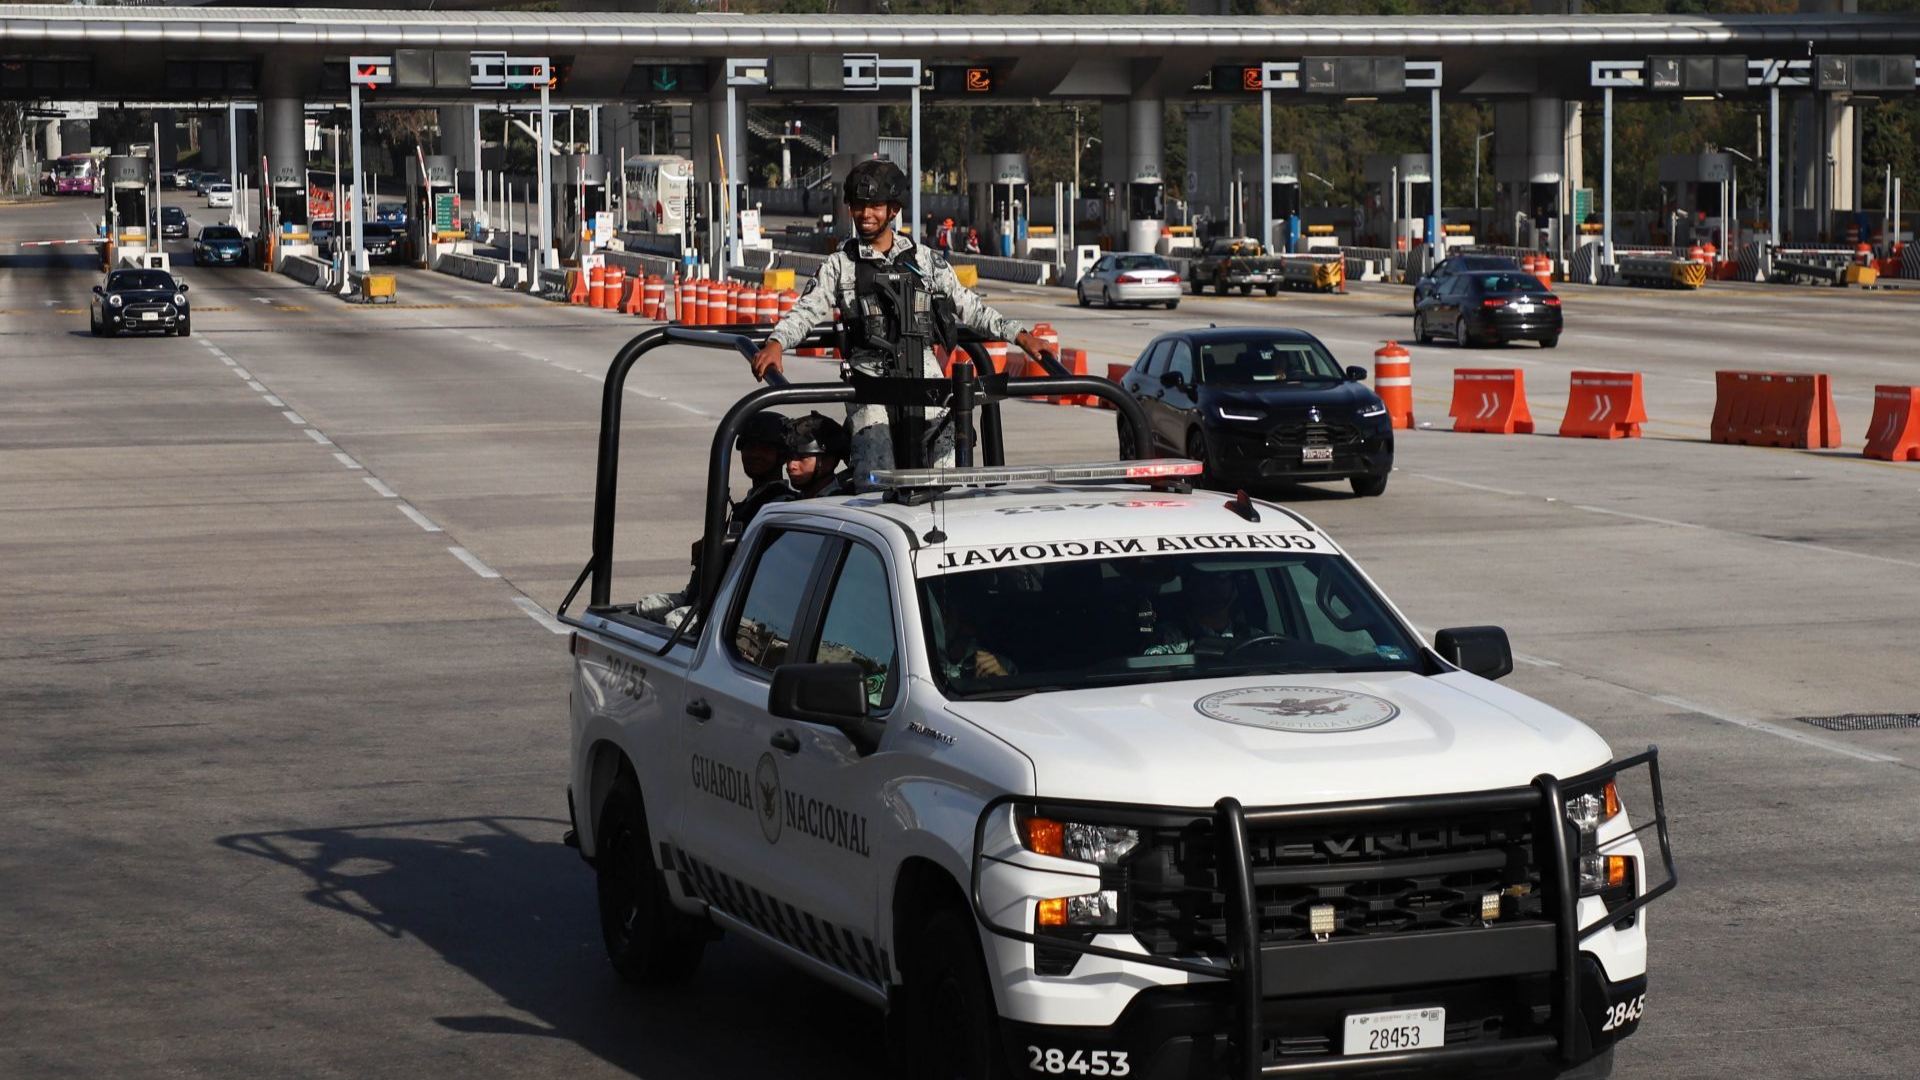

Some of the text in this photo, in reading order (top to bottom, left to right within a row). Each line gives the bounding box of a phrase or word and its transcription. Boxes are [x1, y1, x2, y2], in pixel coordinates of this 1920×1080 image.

[604, 655, 647, 700] 28453
[691, 753, 870, 858] GUARDIA NACIONAL
[1601, 993, 1646, 1032] 2845
[1369, 1026, 1421, 1050] 28453
[1027, 1045, 1131, 1077] 28453
